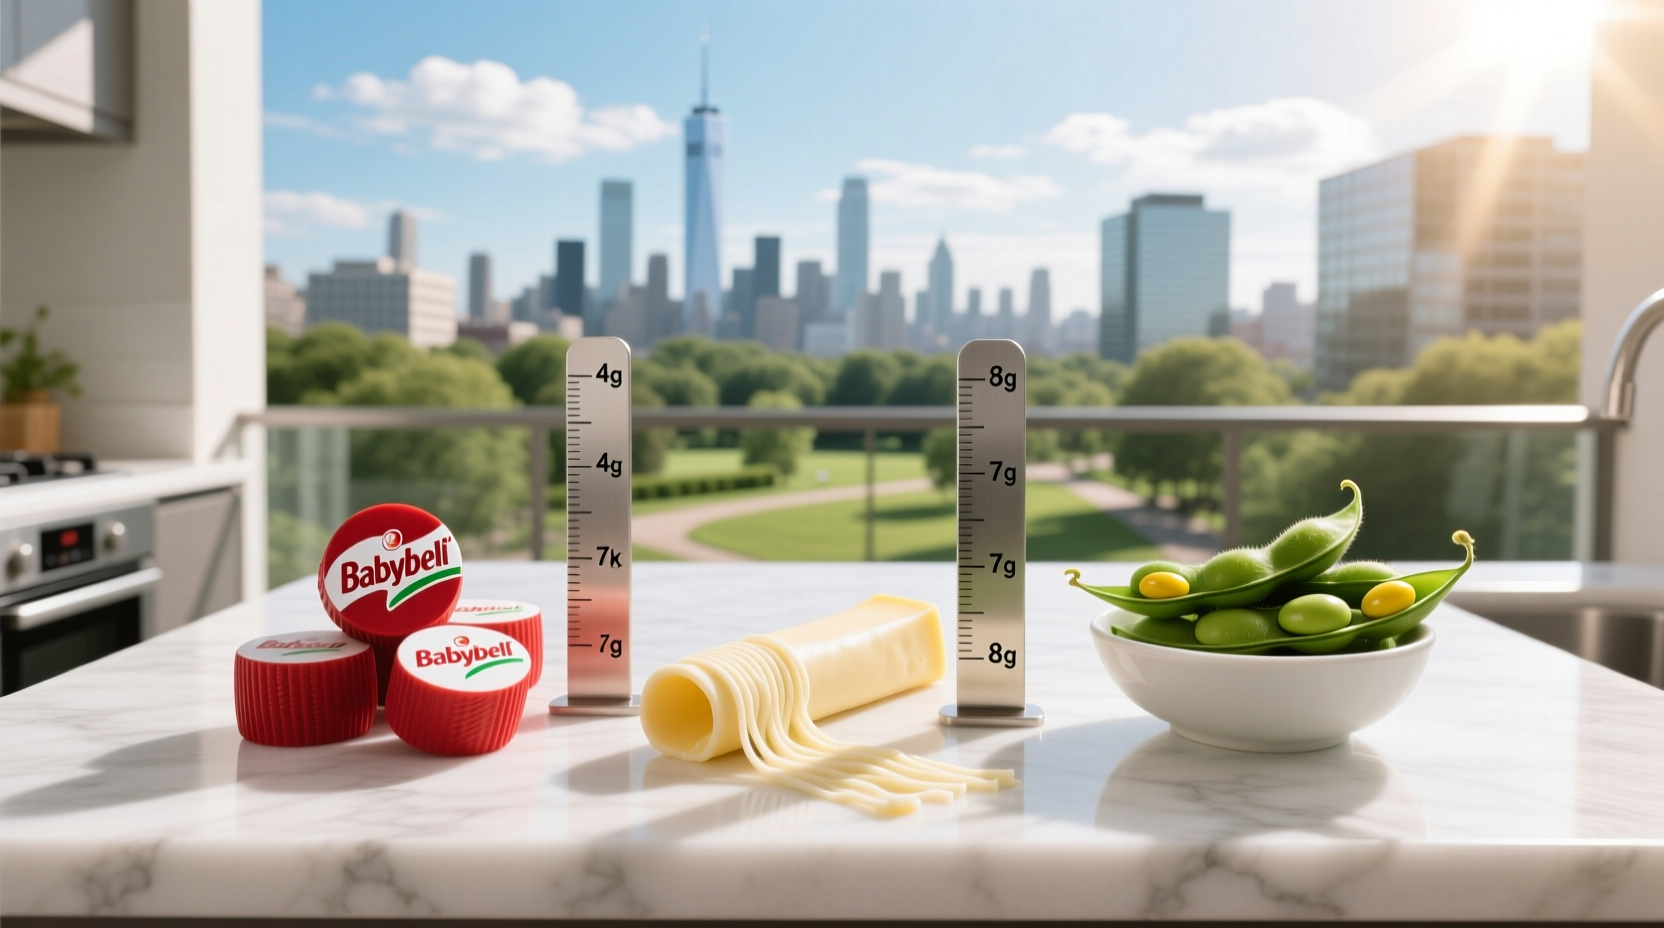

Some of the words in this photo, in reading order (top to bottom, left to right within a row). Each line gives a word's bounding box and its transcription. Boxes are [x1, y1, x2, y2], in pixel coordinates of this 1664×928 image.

[596, 363, 622, 388] 4g
[989, 365, 1016, 392] 8g
[596, 452, 622, 478] 4g
[989, 461, 1016, 486] 7g
[596, 546, 622, 568] 7k
[989, 553, 1016, 579] 7g
[415, 641, 512, 668] Babybell
[600, 634, 622, 658] 7g
[988, 642, 1016, 669] 8g
